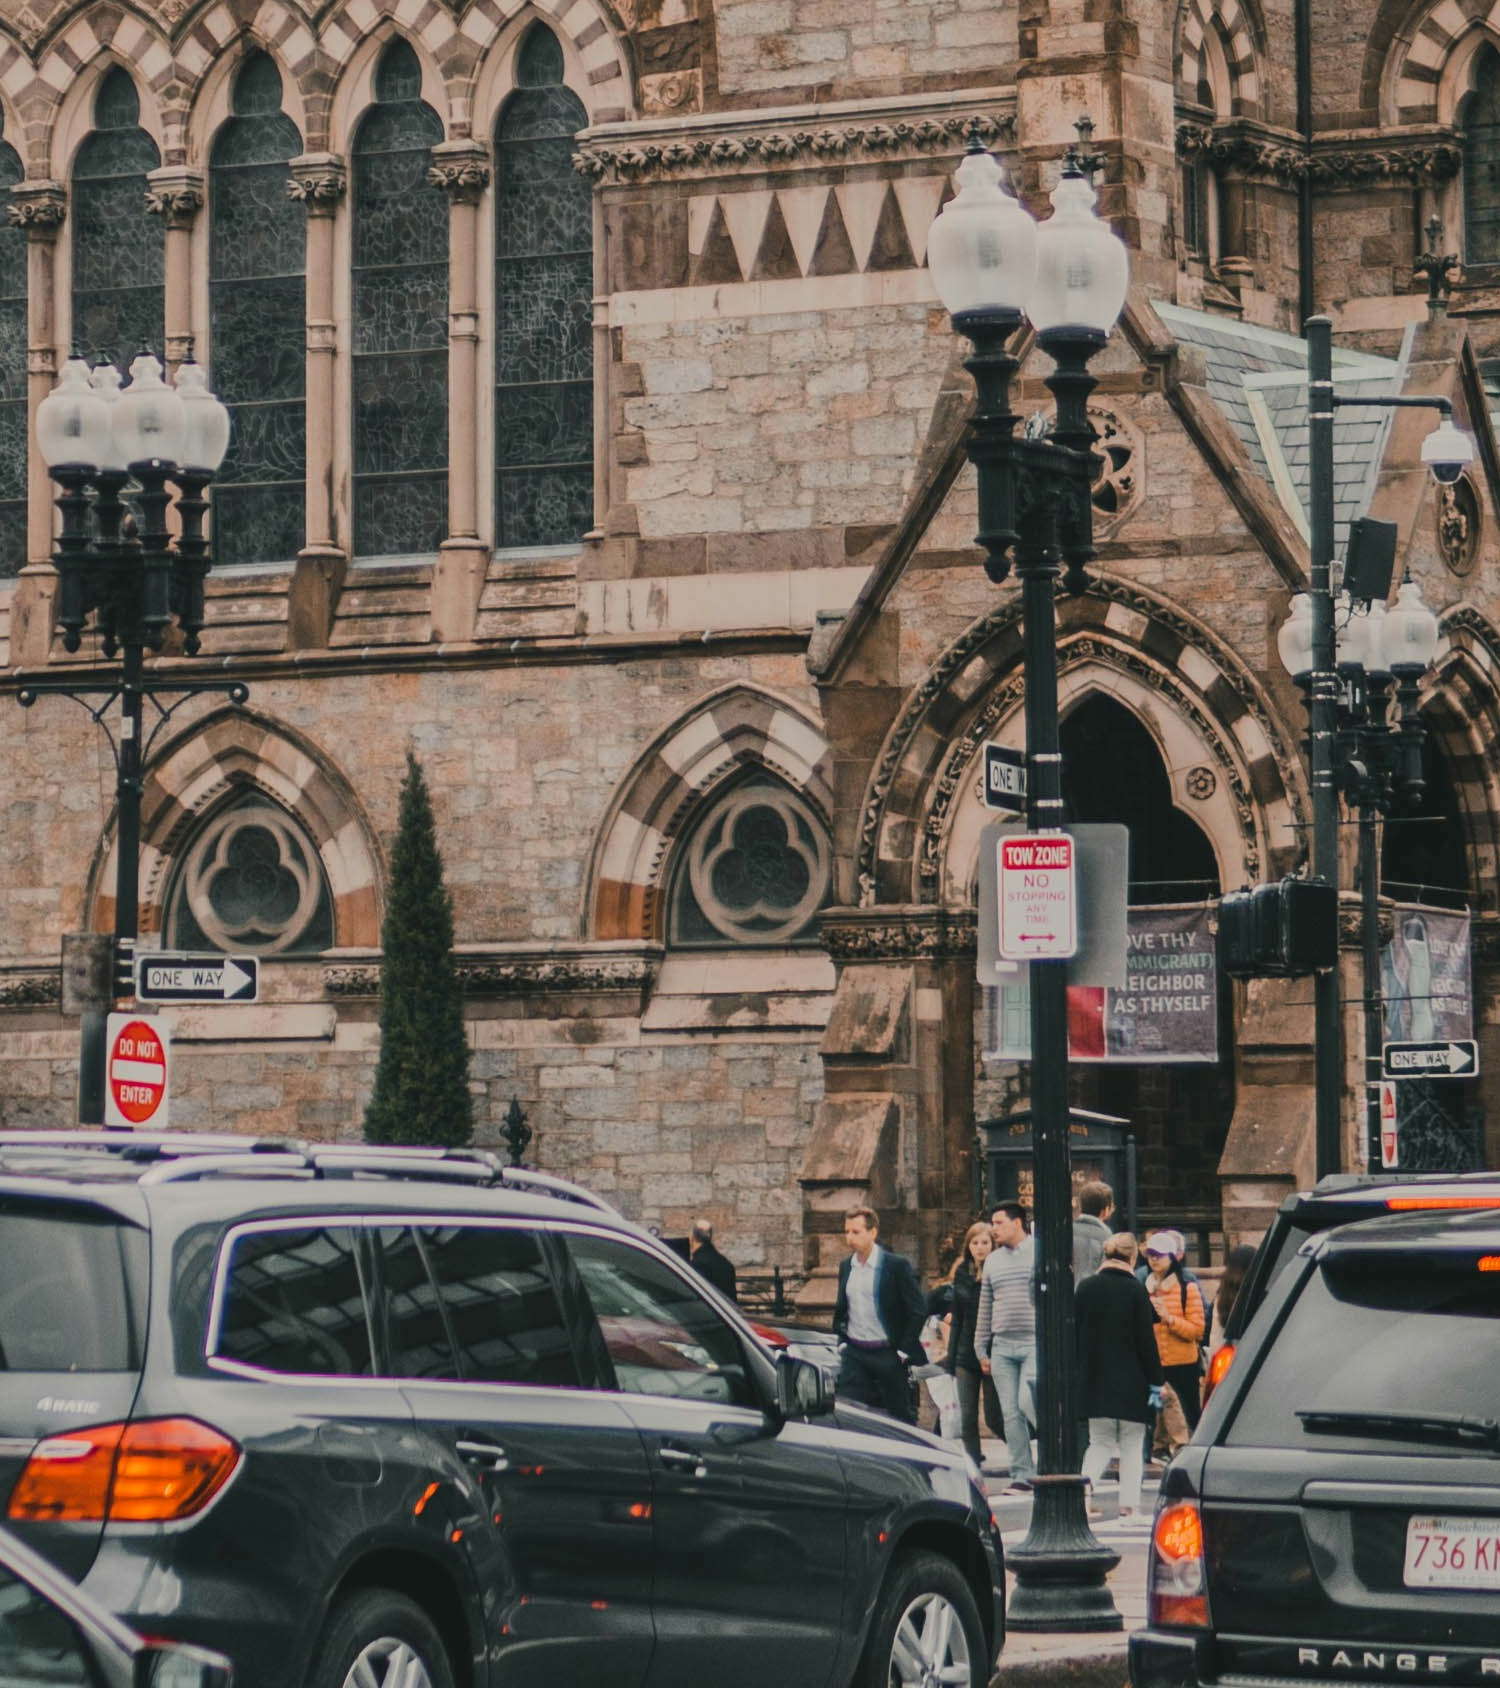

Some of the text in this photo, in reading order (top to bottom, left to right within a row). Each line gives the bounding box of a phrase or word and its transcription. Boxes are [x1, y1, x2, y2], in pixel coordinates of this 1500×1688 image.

[992, 765, 1013, 791] ONE
[1006, 846, 1068, 866] TOW ZONE
[1023, 874, 1049, 889] NO
[1008, 892, 1066, 902] STOPPING
[1026, 904, 1048, 913] ANY
[1026, 915, 1049, 925] TIME
[1126, 931, 1198, 950] VE THY
[152, 970, 224, 986] ONE WAY
[1114, 974, 1206, 992] EIGHBOR
[1113, 994, 1211, 1014] AS THYSELF
[119, 1038, 158, 1058] DO NOT
[1394, 1053, 1450, 1066] ONE WAY
[119, 1085, 154, 1104] ENTER
[1413, 1535, 1466, 1571] 736
[1298, 1647, 1448, 1673] RANGE
